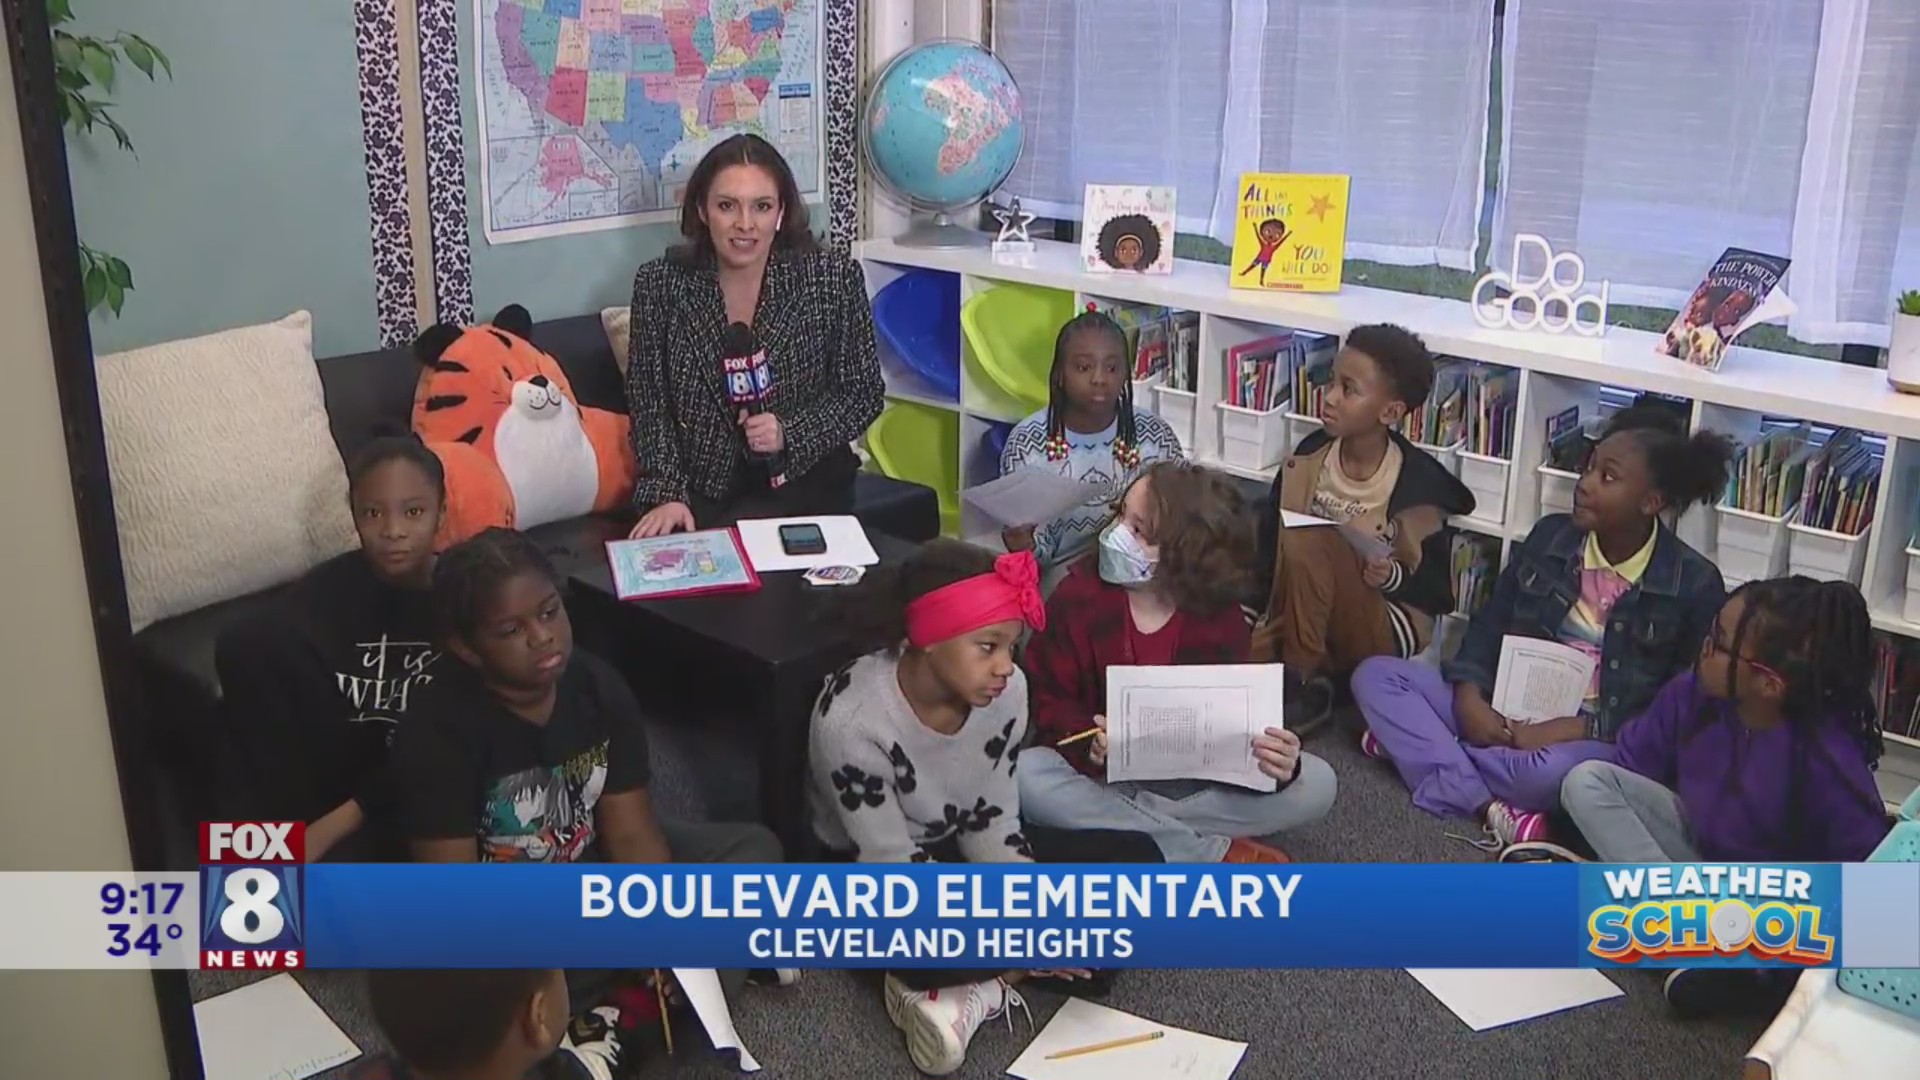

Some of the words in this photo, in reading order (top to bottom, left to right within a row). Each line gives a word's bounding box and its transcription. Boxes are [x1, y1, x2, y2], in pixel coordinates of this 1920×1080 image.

[1293, 244, 1325, 261] YOU
[1510, 233, 1584, 294] Do
[1714, 260, 1741, 274] THE
[1740, 261, 1778, 289] POWER
[1471, 272, 1610, 337] Good
[723, 355, 750, 371] FOX
[733, 371, 751, 395] 8
[758, 365, 768, 389] 8
